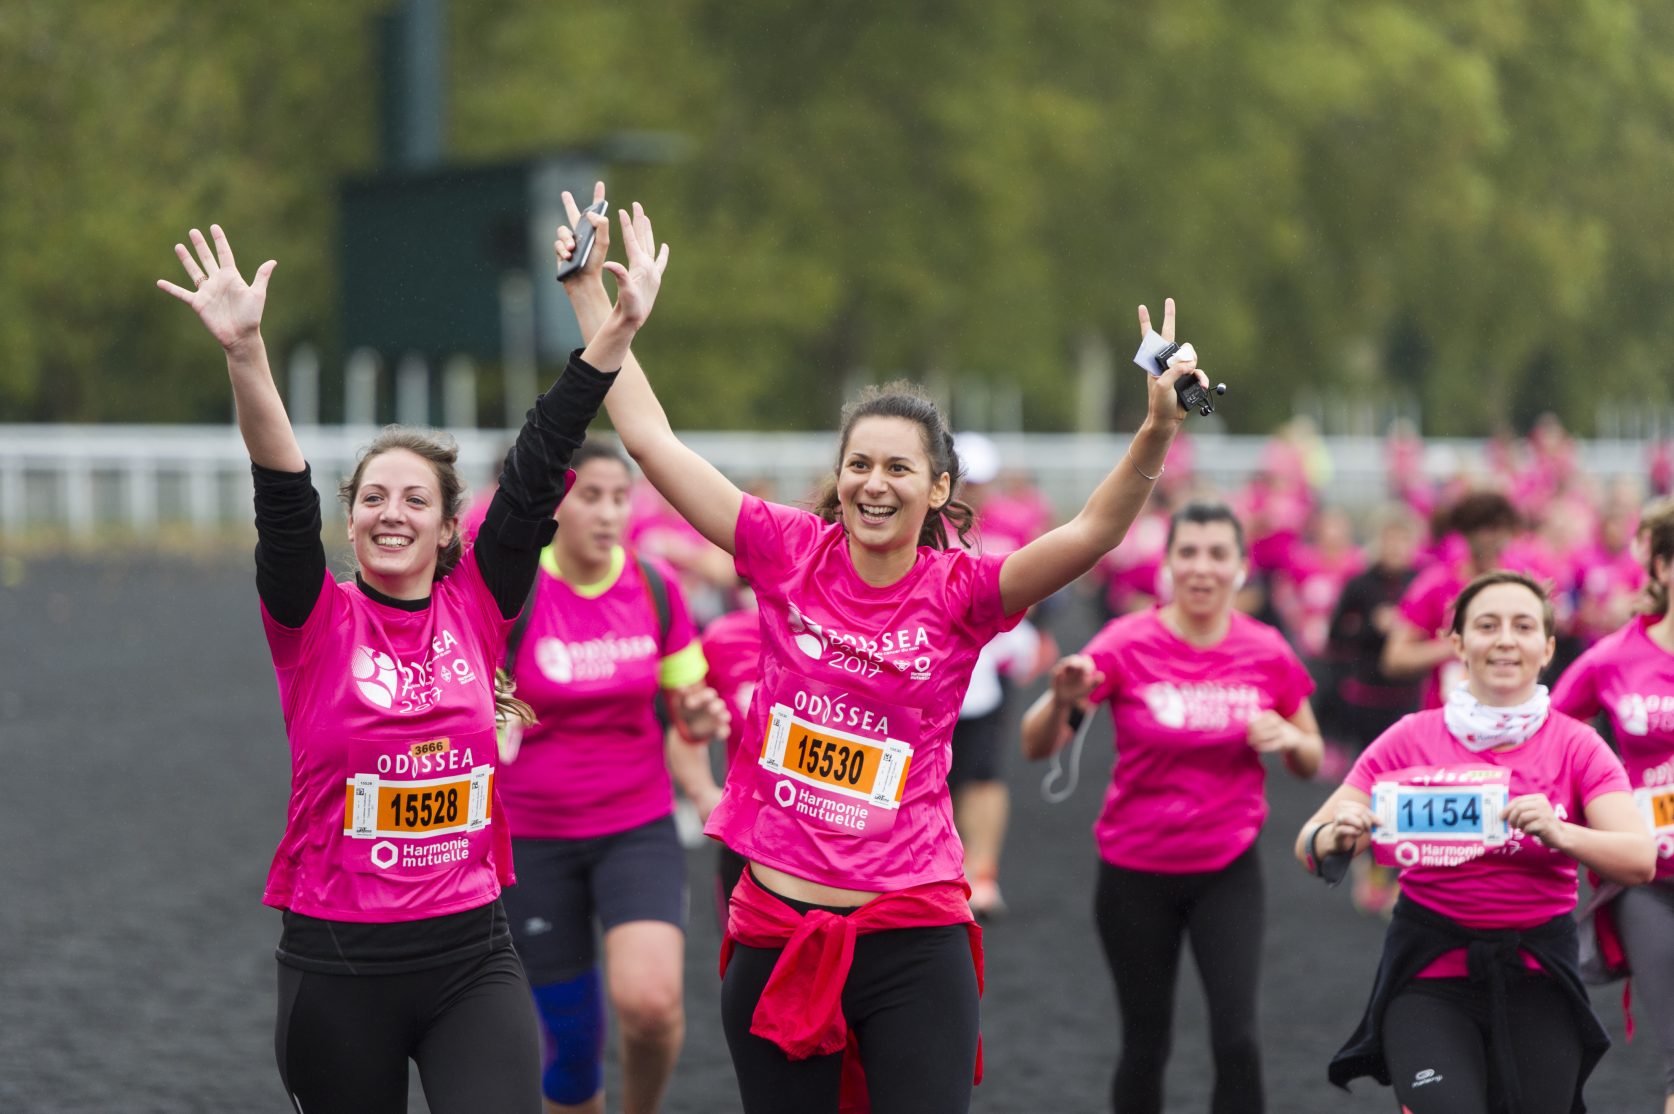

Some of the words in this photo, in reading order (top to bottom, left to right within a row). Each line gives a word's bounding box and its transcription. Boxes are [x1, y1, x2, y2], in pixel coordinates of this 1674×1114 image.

[828, 652, 883, 678] 2017
[794, 690, 888, 735] ODYSSEA
[377, 747, 474, 779] ODYSSEA
[415, 741, 443, 756] 3666
[798, 735, 864, 785] 15530
[391, 788, 458, 827] 15528
[796, 801, 866, 830] mutuelle
[799, 788, 869, 819] Harmonie
[1402, 796, 1480, 827] 1154
[402, 836, 469, 856] Harmonie
[402, 848, 469, 867] mutuelle
[1421, 843, 1486, 858] Harmonie
[1421, 854, 1478, 868] mutue
